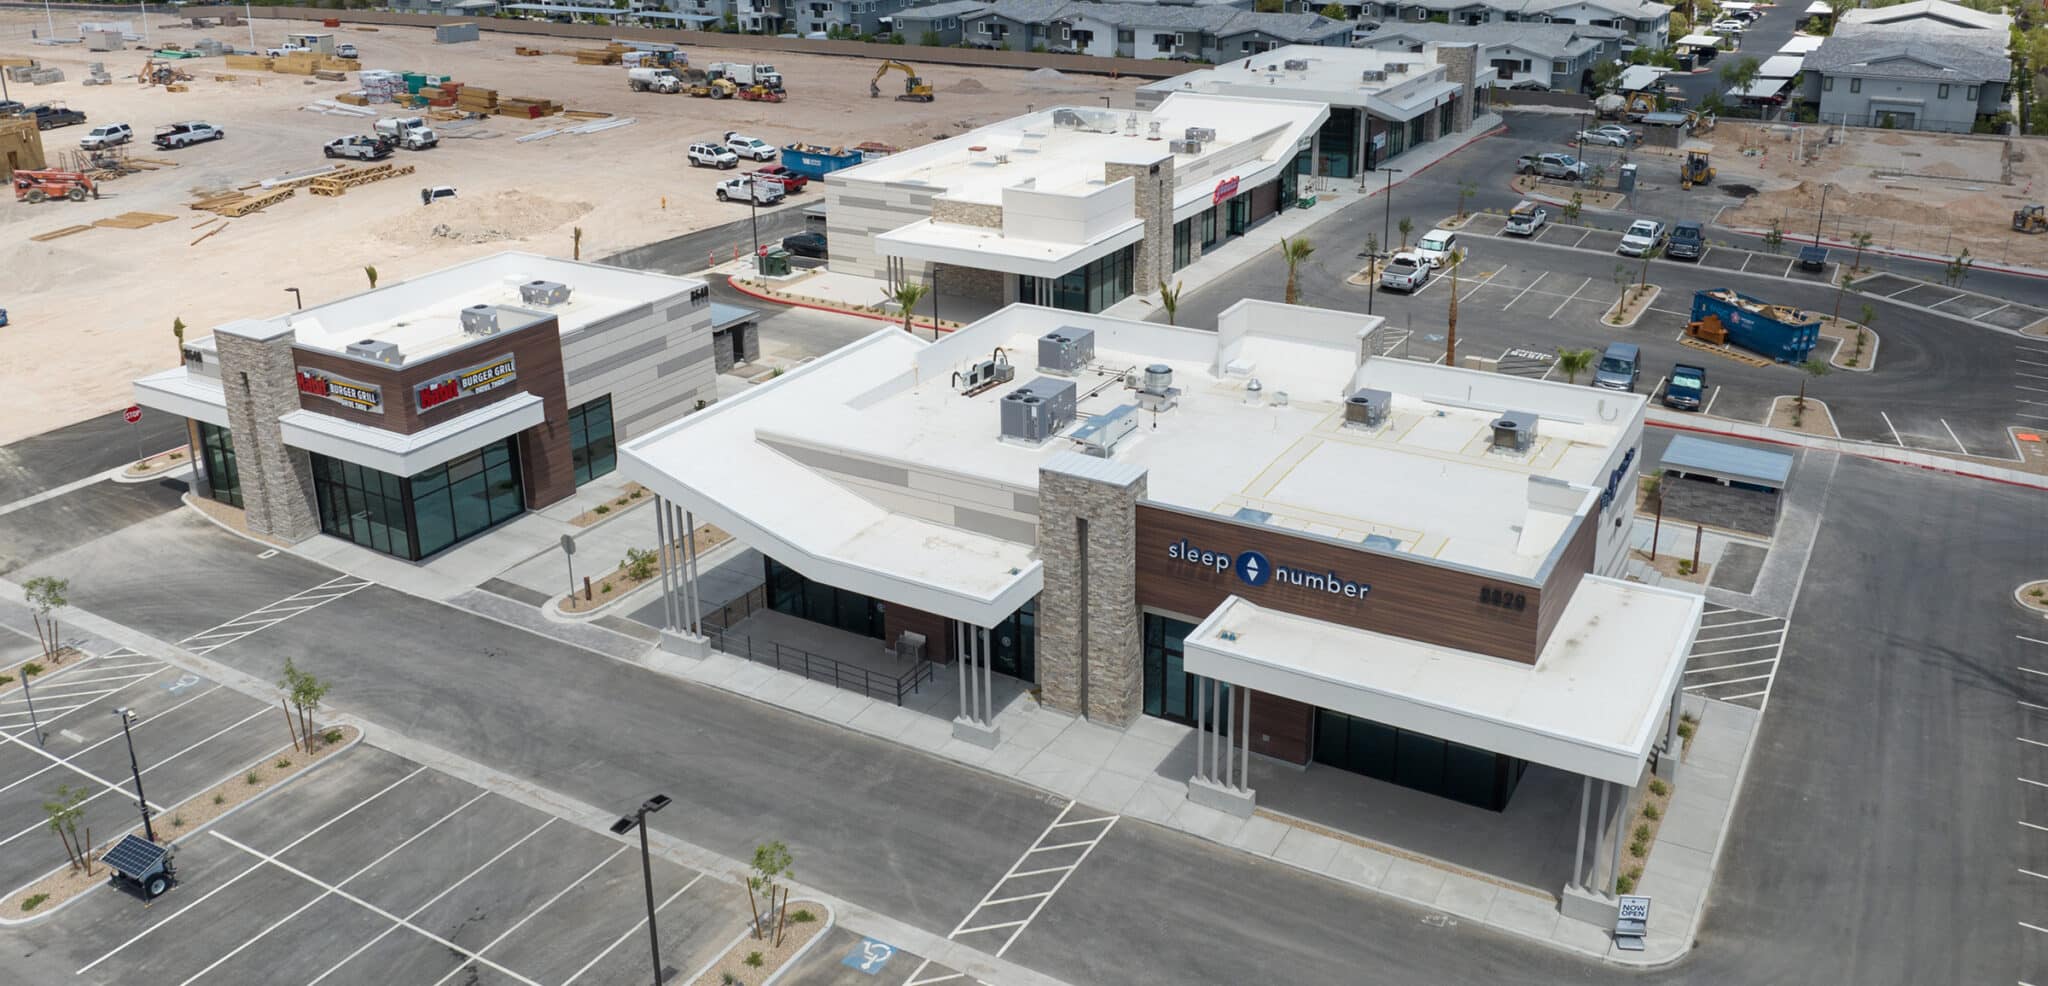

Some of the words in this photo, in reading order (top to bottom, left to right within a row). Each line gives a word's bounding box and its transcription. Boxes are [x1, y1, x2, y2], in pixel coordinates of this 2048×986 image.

[462, 370, 494, 388] BURGER
[494, 362, 515, 376] GRILL
[329, 383, 357, 398] BURGER
[357, 389, 377, 404] GRILL
[420, 378, 459, 409] Habit
[125, 410, 140, 418] STOP
[1168, 541, 1230, 573] sleep
[1276, 567, 1369, 599] number
